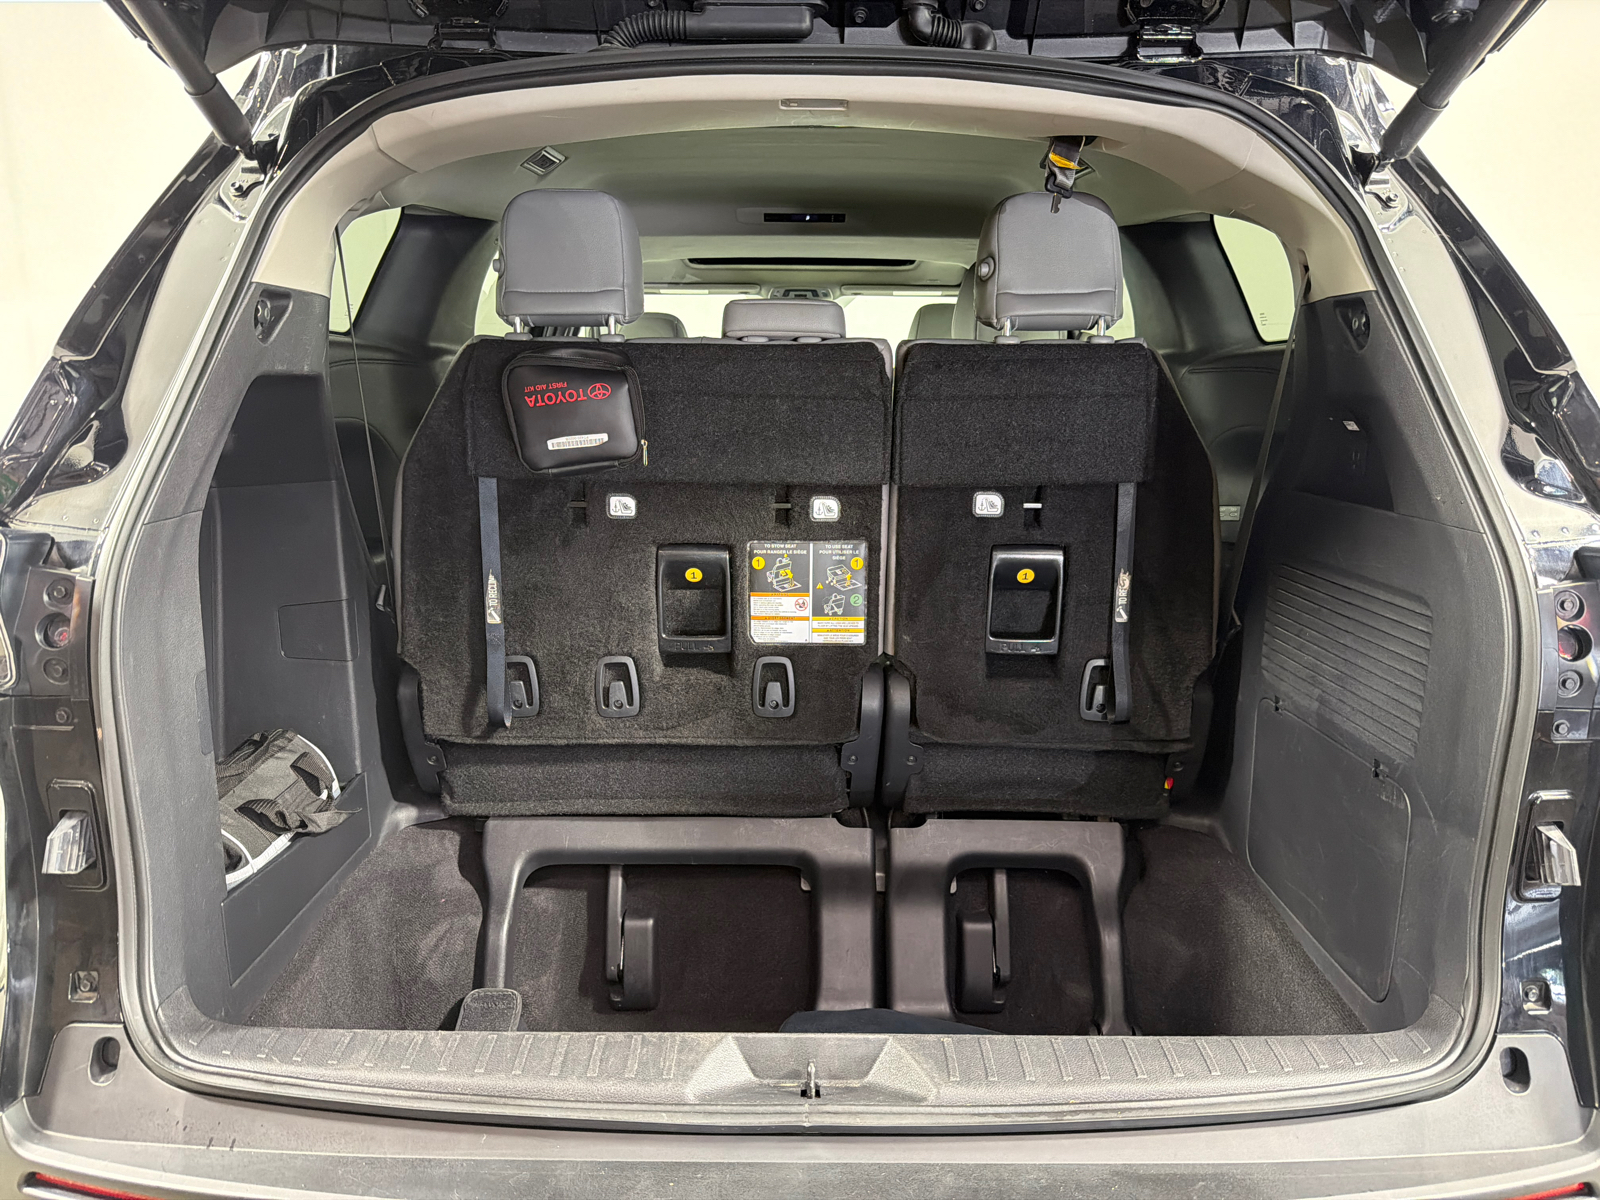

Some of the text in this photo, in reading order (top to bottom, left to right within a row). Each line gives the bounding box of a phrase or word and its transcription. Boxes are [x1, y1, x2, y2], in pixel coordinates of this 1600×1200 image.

[524, 389, 587, 407] TOYOTA
[756, 558, 760, 568] 1
[1022, 572, 1028, 580] 1
[488, 576, 497, 598] RECLIN
[853, 595, 860, 605] 2
[1118, 597, 1127, 605] TO
[674, 642, 700, 651] PULL
[1000, 643, 1026, 652] PULL
